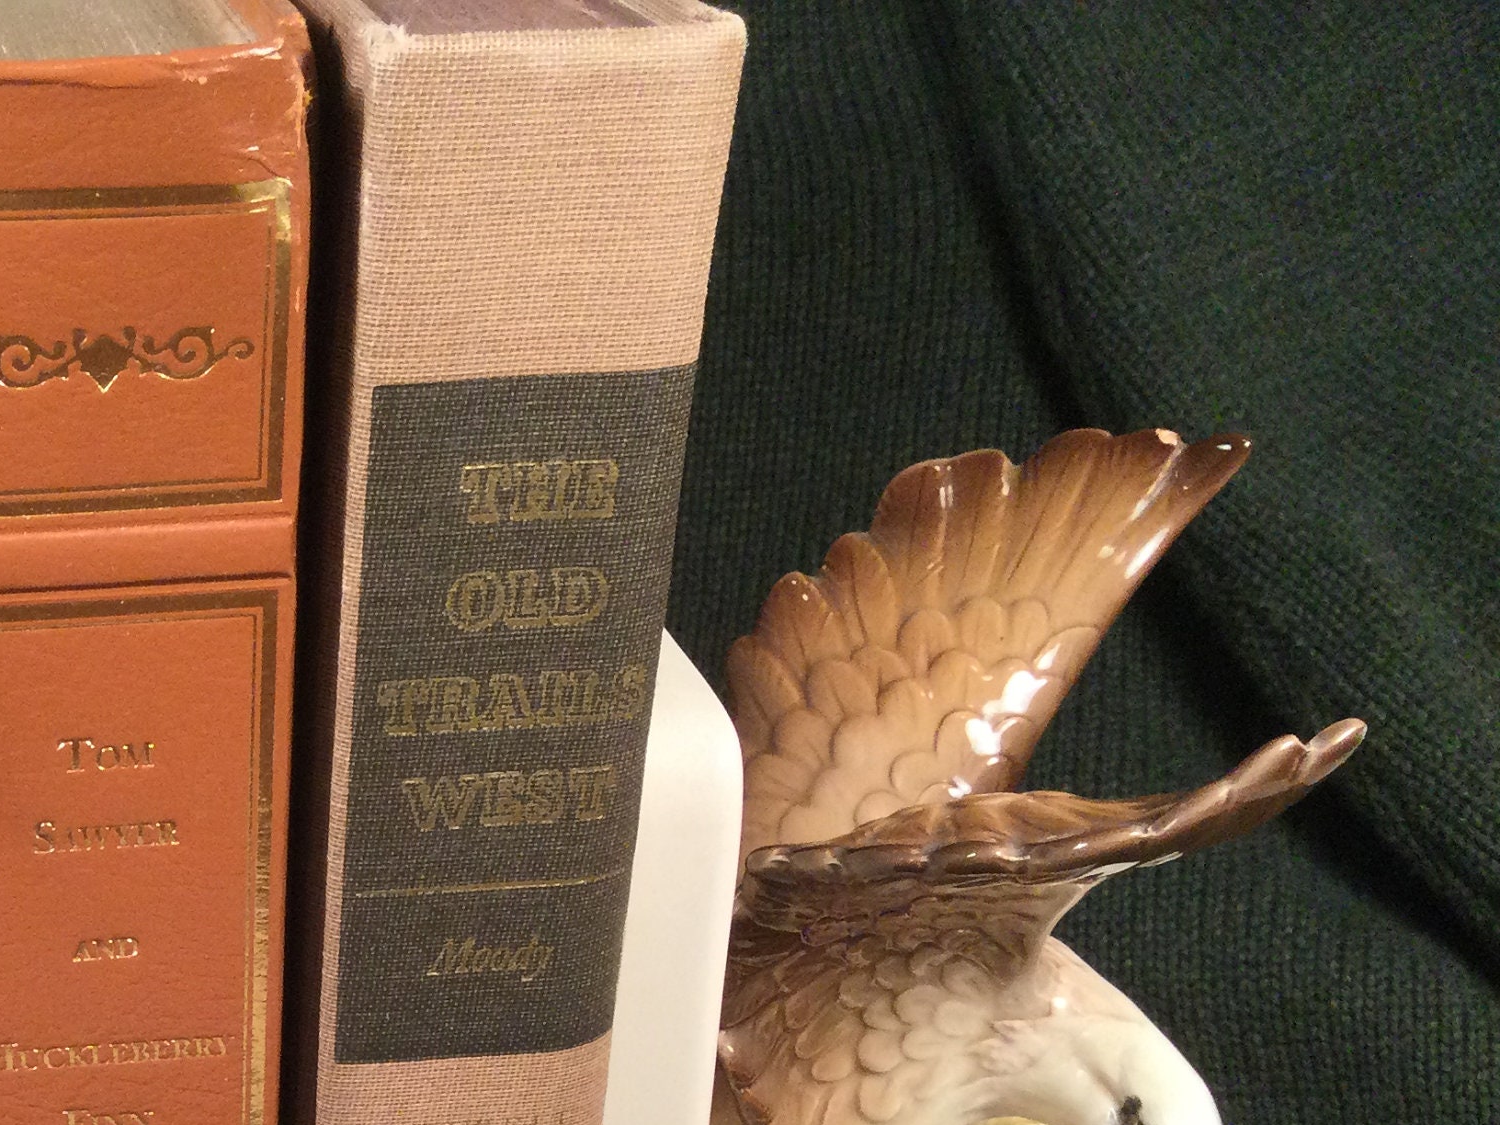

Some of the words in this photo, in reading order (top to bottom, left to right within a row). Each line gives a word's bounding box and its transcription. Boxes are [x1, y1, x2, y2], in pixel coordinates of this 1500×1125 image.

[460, 458, 619, 524] THE
[446, 566, 608, 632] OLD
[377, 662, 646, 736] TRAILS
[402, 766, 617, 832] WEST
[427, 937, 554, 982] Moody
